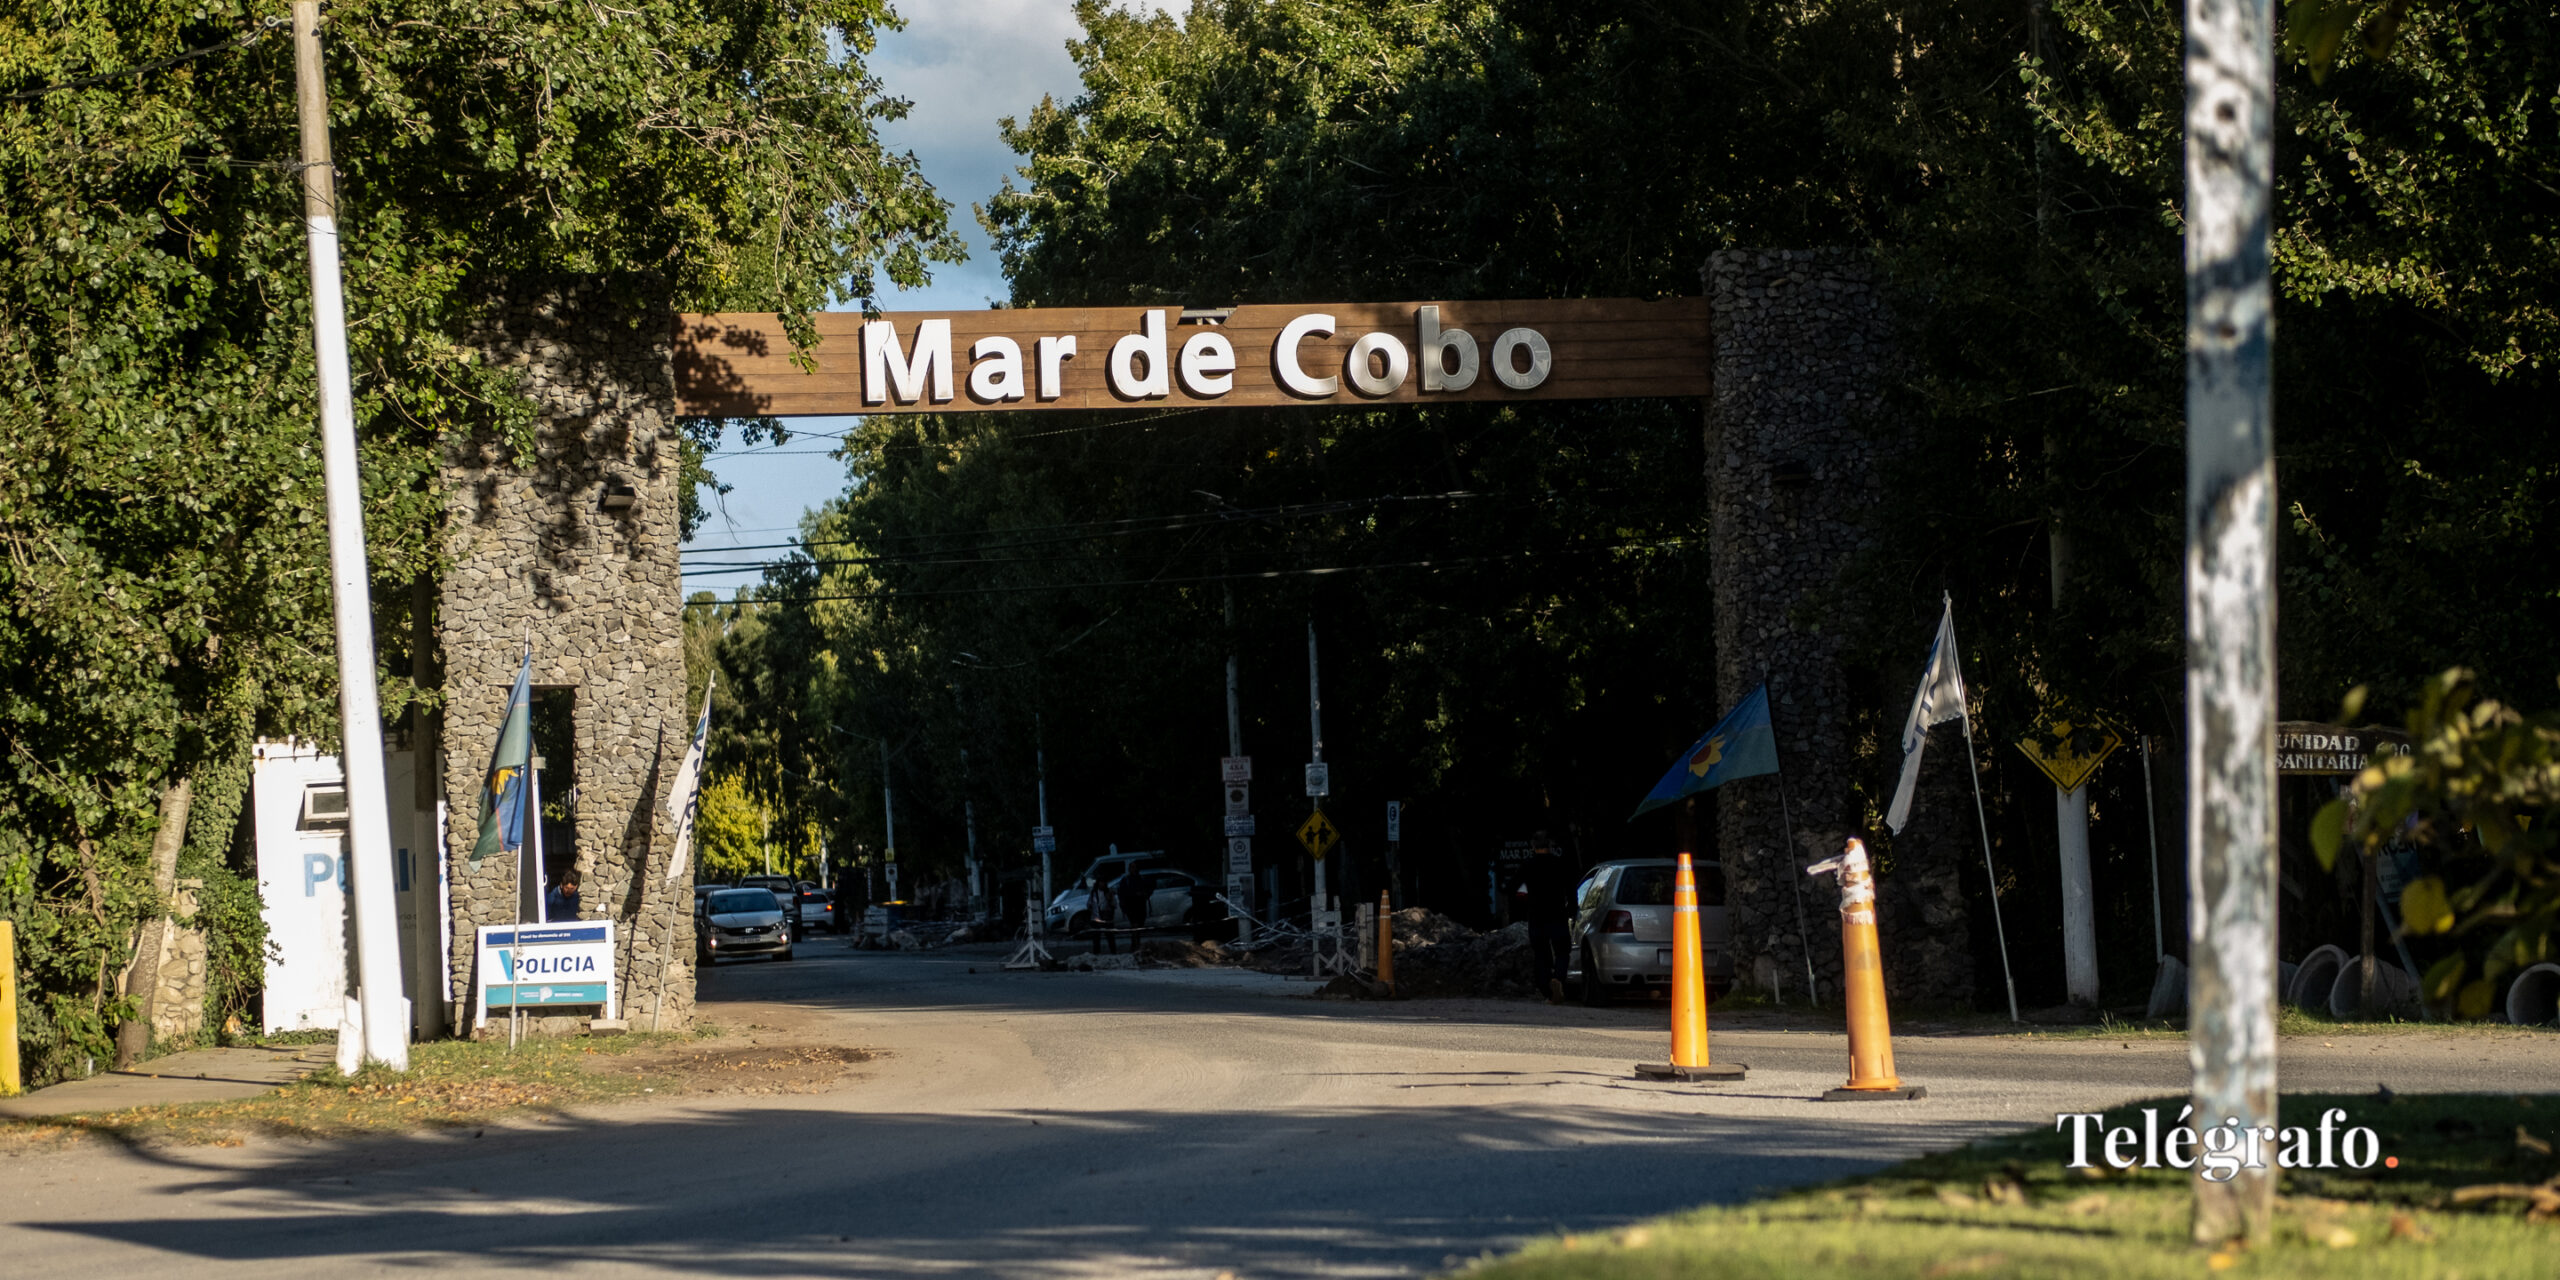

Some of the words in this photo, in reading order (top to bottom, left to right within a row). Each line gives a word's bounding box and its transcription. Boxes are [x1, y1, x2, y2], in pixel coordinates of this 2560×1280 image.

[861, 318, 1076, 402] Mar
[1109, 309, 1237, 399] de
[1272, 303, 1552, 397] Cobo
[2275, 733, 2361, 752] UNIDAD
[2276, 753, 2369, 770] SANITARIA
[511, 956, 595, 975] POLICIA
